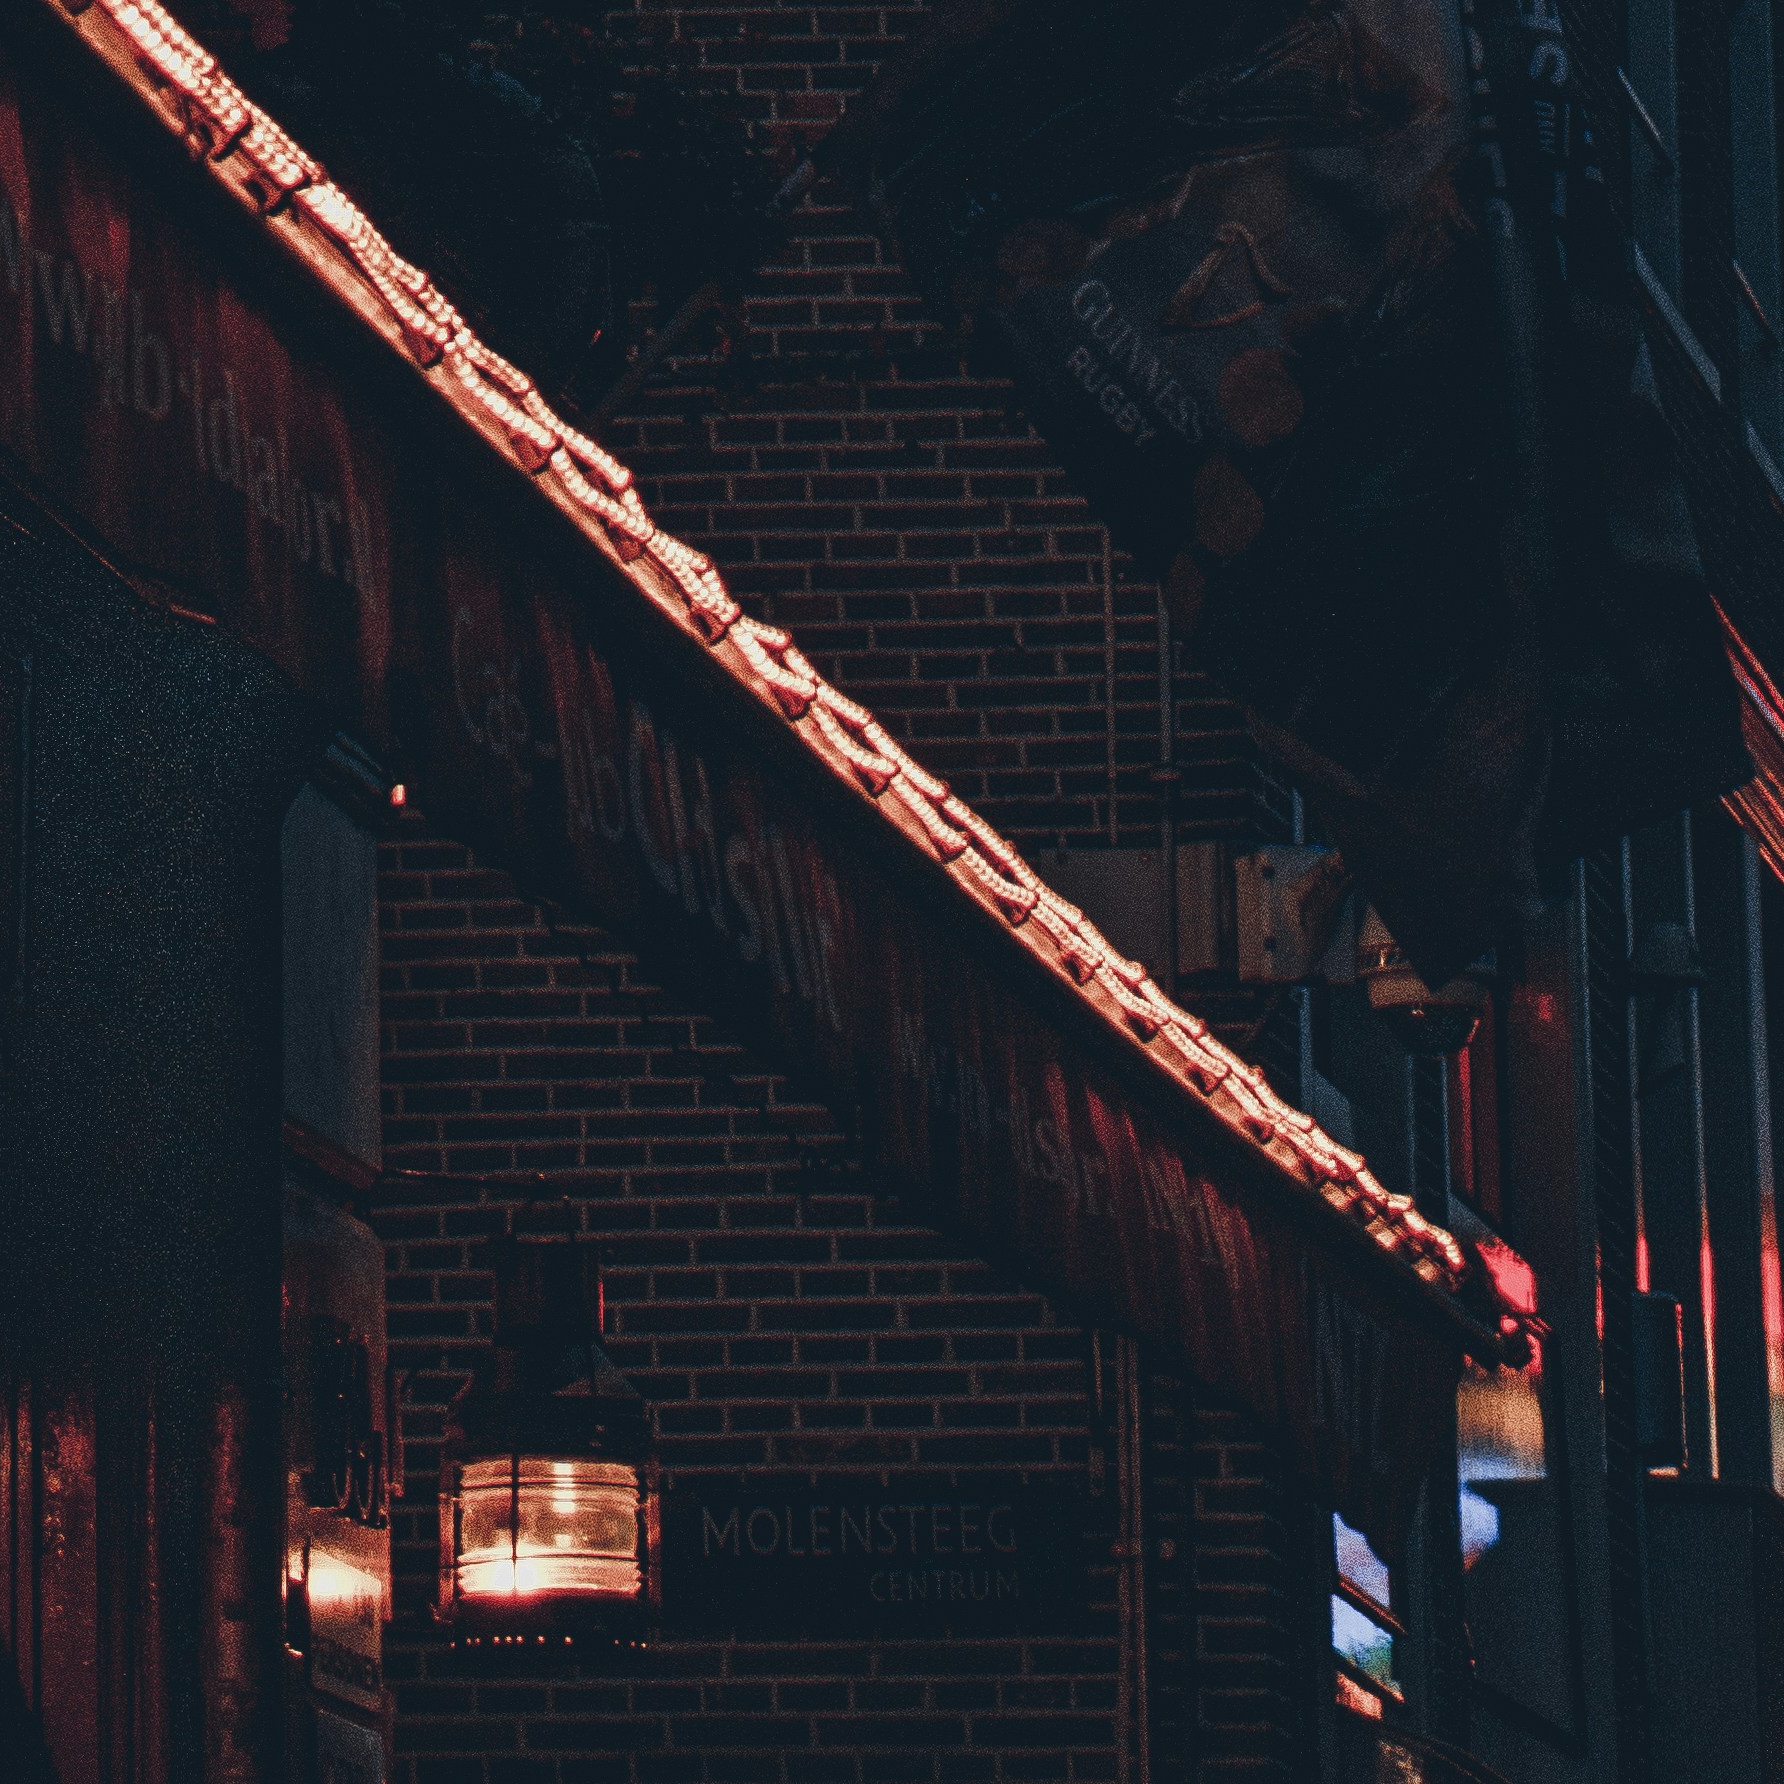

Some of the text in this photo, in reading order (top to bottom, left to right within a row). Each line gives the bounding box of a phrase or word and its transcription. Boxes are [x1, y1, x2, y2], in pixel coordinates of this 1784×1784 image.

[1064, 343, 1159, 449] RUGBY
[1069, 277, 1206, 445] GUINNESS
[702, 1504, 1017, 1556] MOLENSTEEG
[870, 1570, 1019, 1601] CENTRUM
